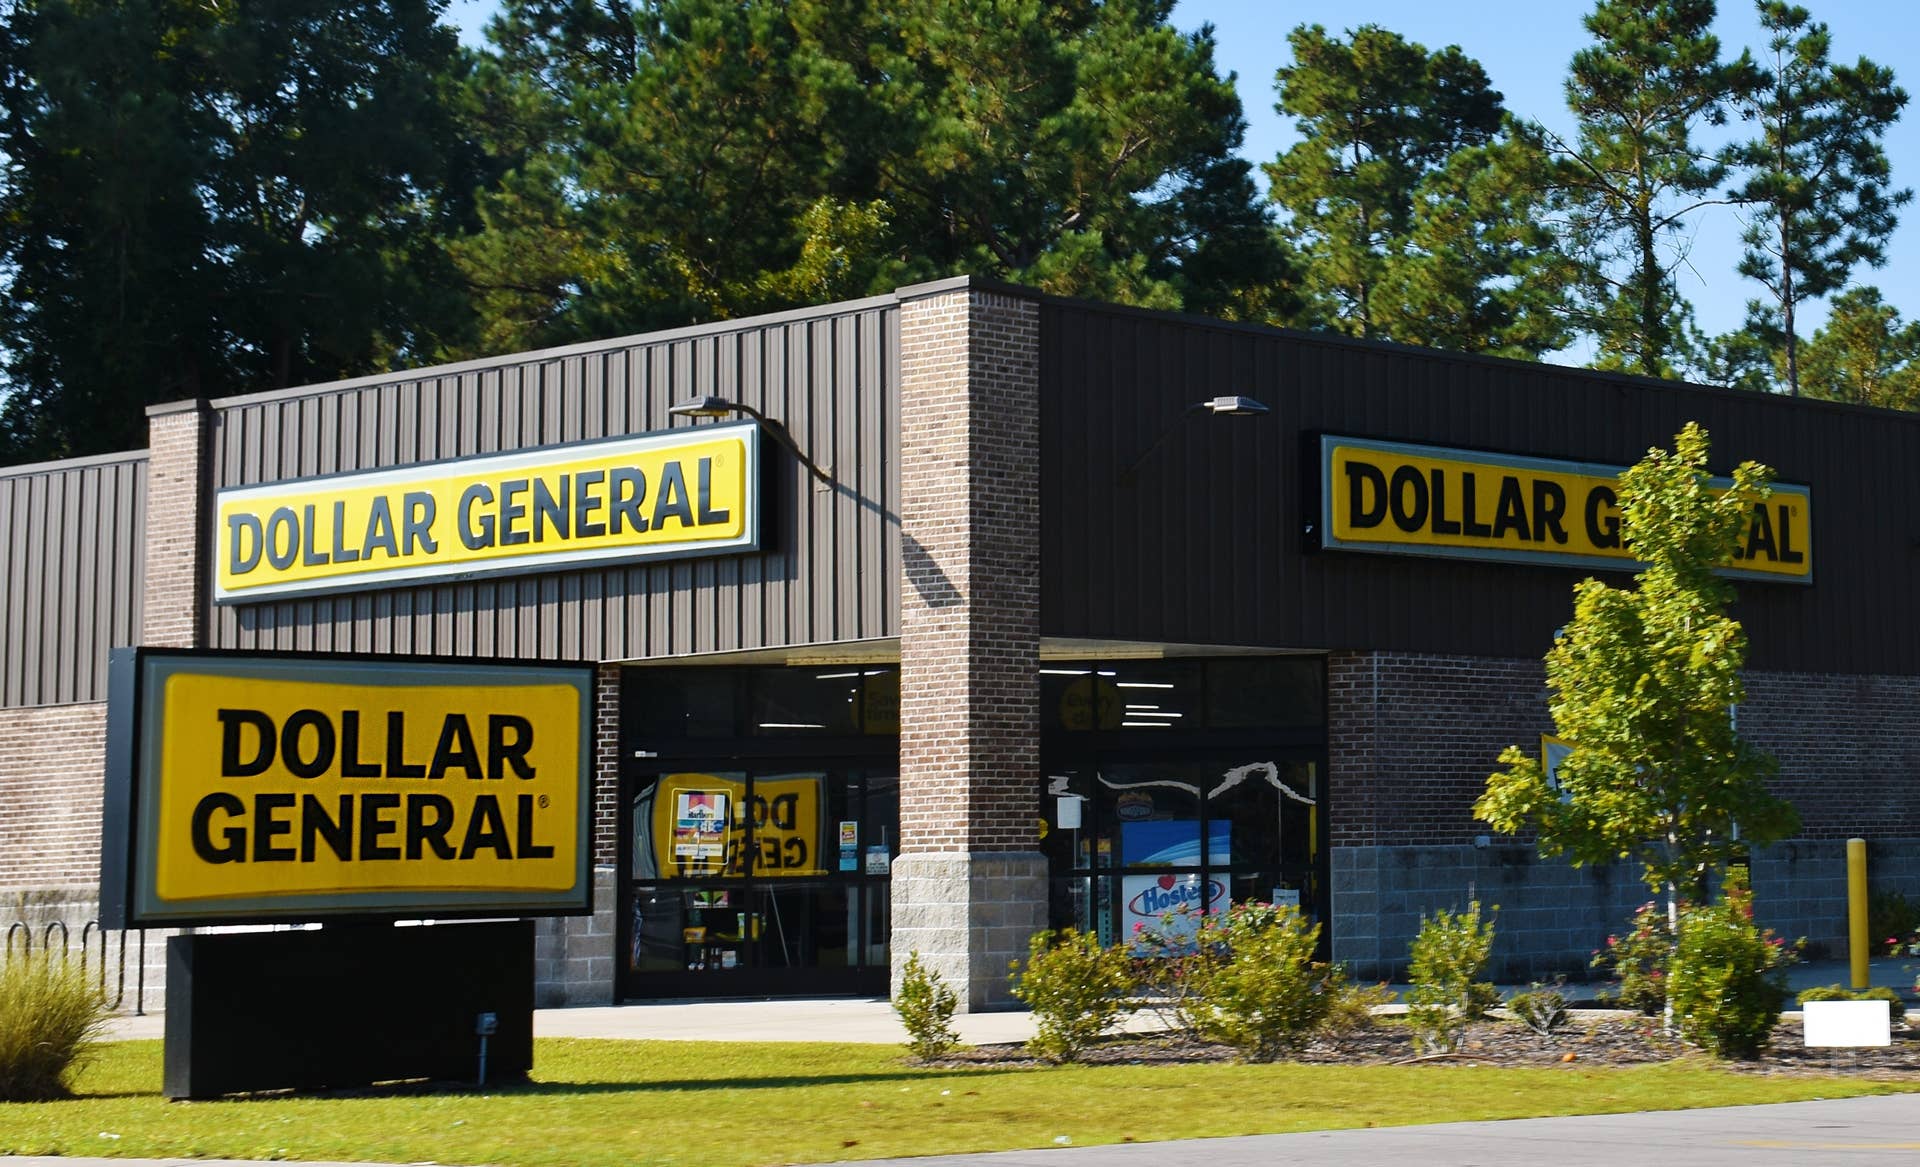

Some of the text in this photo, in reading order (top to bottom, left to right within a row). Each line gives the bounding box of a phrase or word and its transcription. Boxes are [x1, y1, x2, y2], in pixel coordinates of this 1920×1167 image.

[228, 491, 438, 575] DOLLAR
[1344, 461, 1568, 544] DOLLAR
[218, 709, 536, 780] DOLLAR
